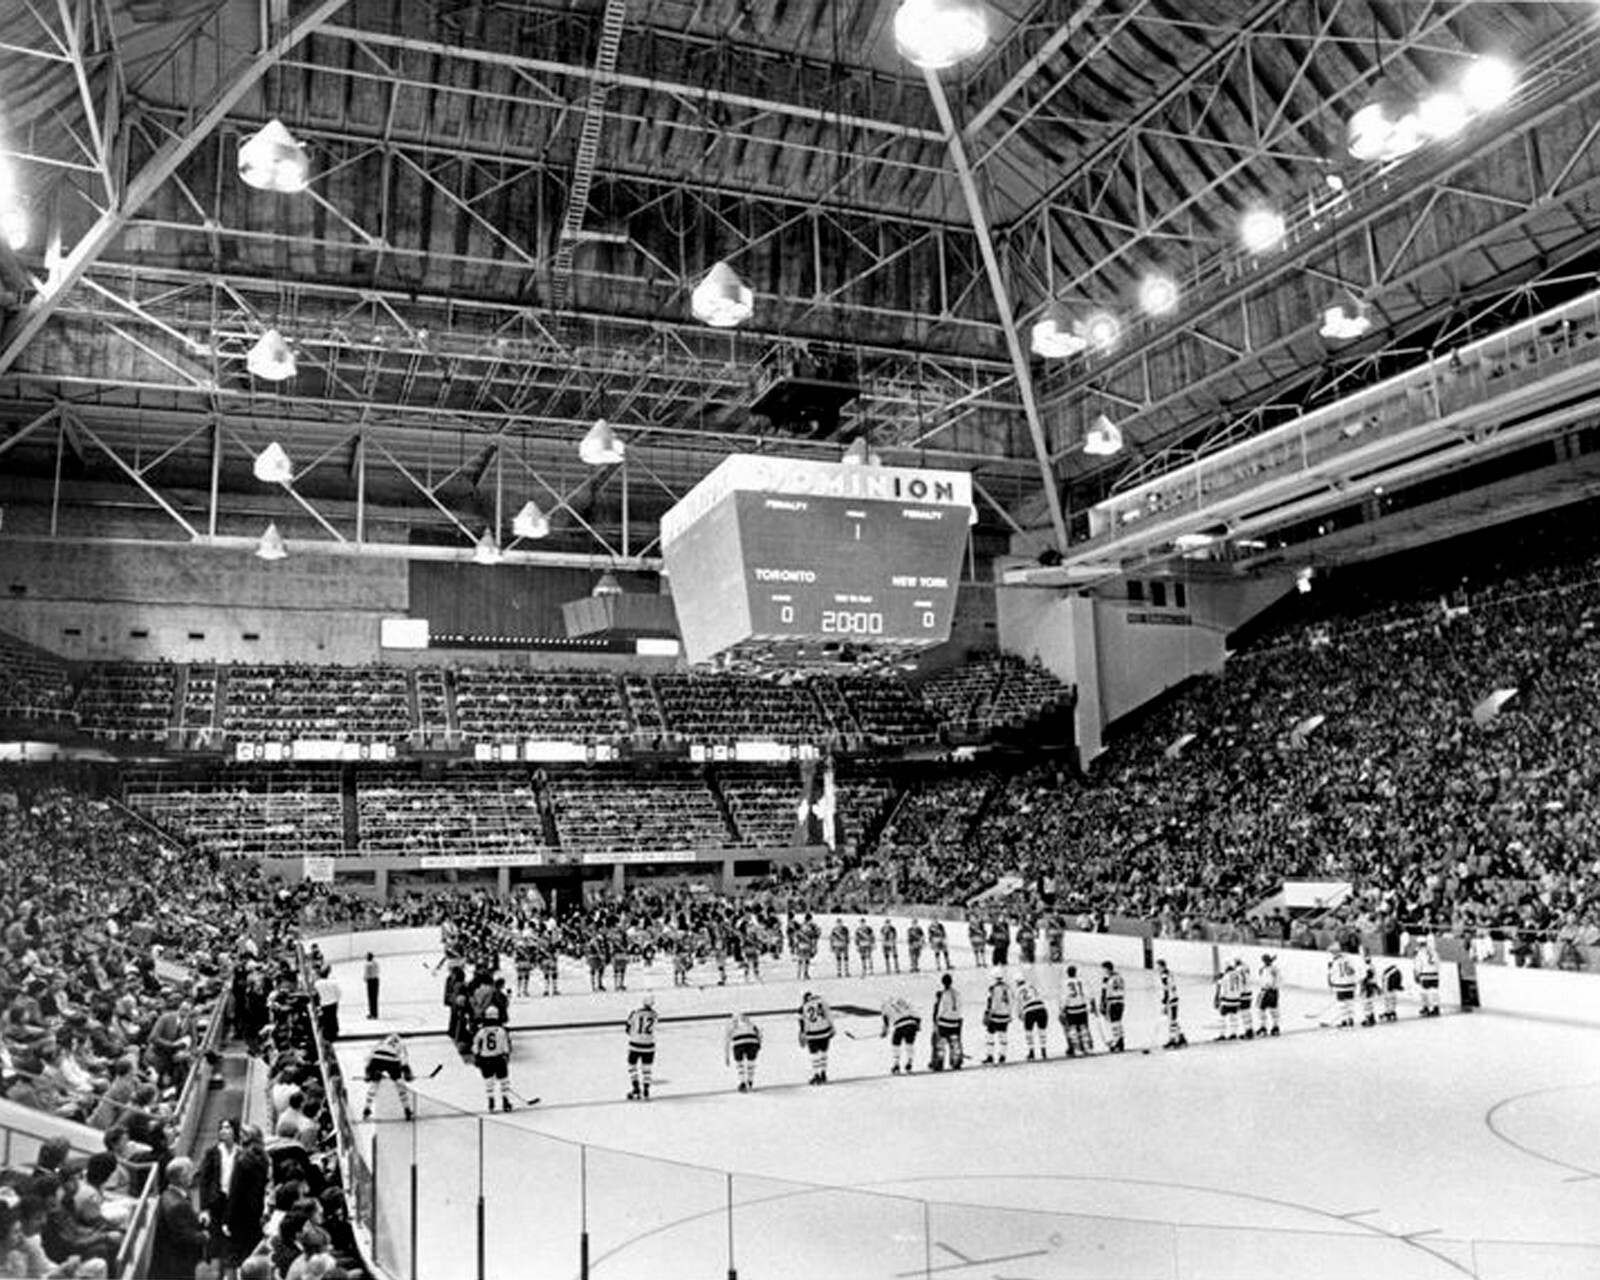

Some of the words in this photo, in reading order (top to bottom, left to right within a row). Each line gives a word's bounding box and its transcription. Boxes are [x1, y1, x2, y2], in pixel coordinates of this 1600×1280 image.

[755, 568, 816, 583] TORONTO
[892, 575, 916, 587] NEW
[919, 576, 948, 589] YORK
[781, 605, 794, 623] 0
[821, 610, 883, 634] 20:00
[922, 610, 935, 628] 0
[1068, 981, 1084, 998] 31
[806, 1003, 827, 1023] 24
[637, 1016, 655, 1035] 12
[486, 1032, 497, 1051] 6
